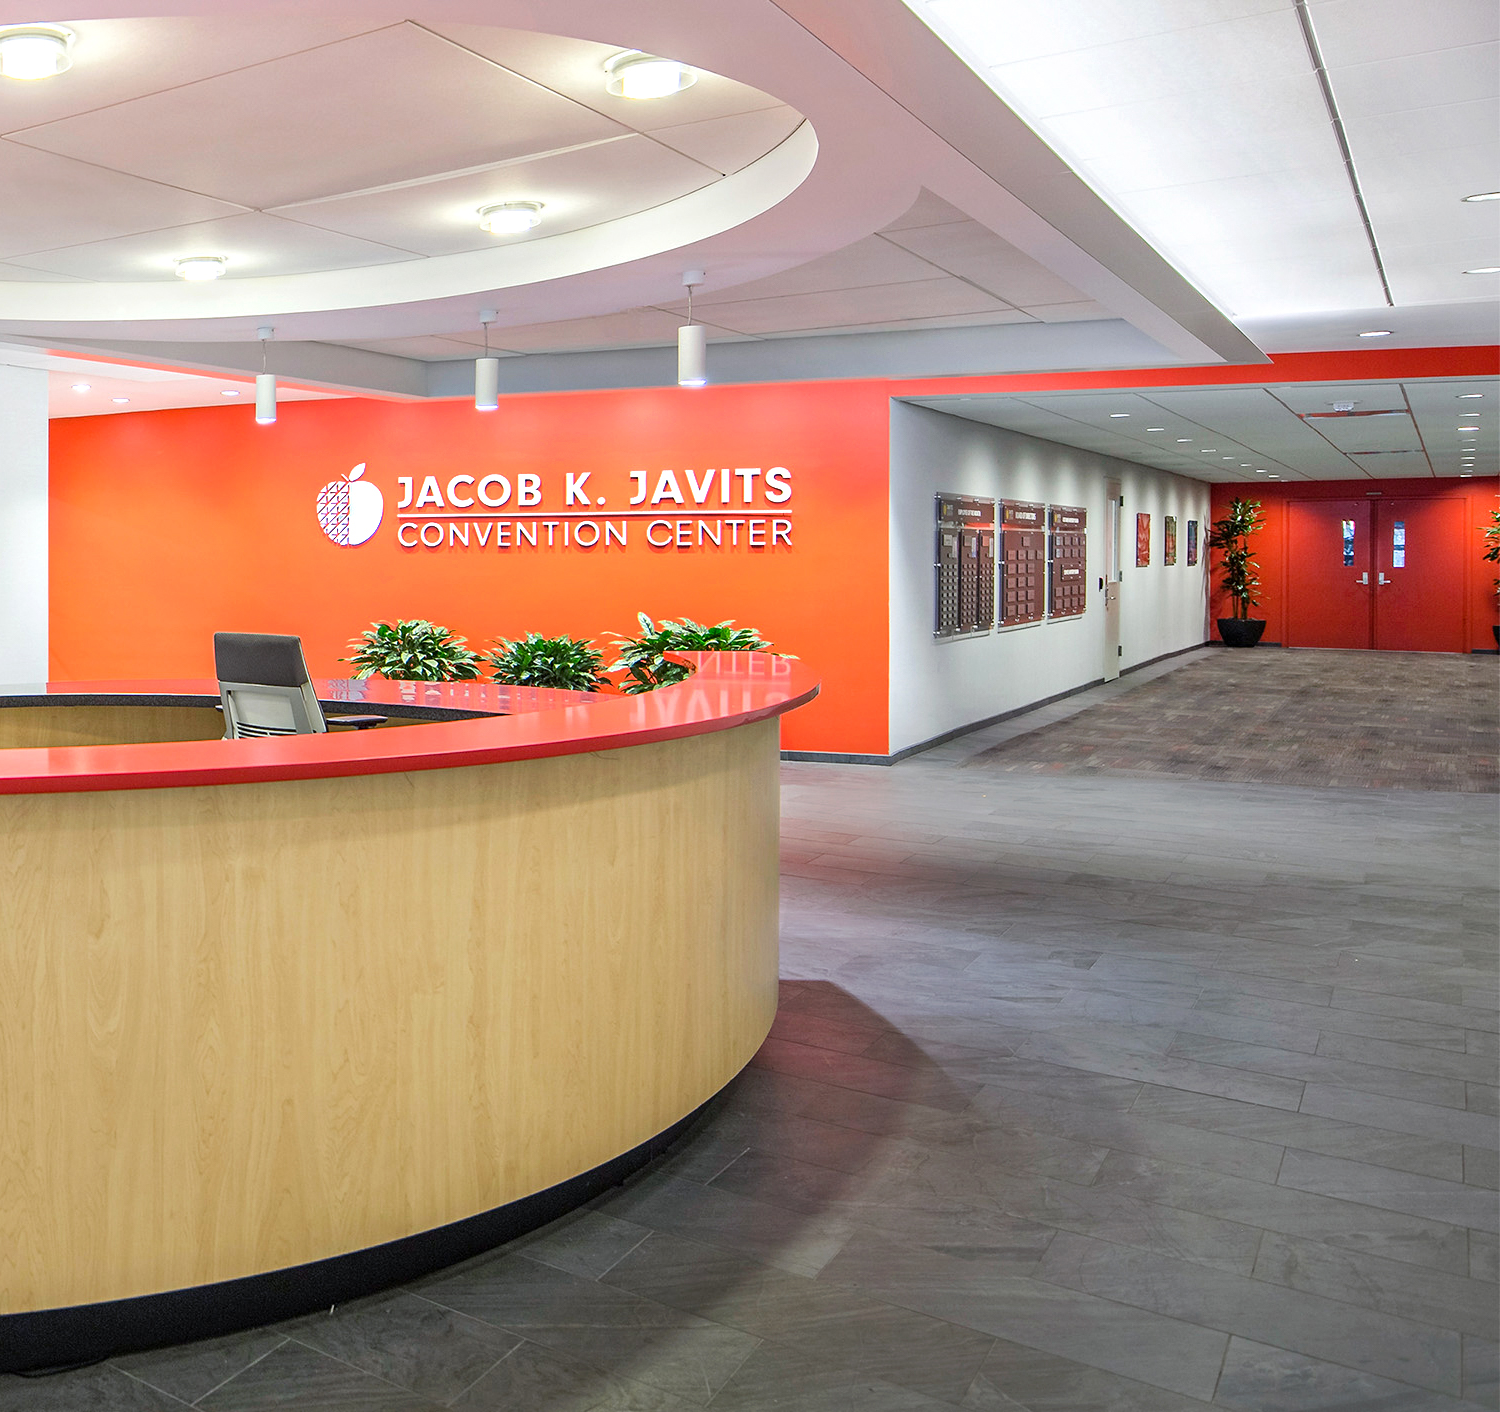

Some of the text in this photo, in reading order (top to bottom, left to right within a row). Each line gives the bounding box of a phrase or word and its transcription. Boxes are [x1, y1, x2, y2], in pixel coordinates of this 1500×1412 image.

[397, 466, 792, 508] JACOB K. JAVITS
[397, 519, 792, 548] CONVENTION CENTER
